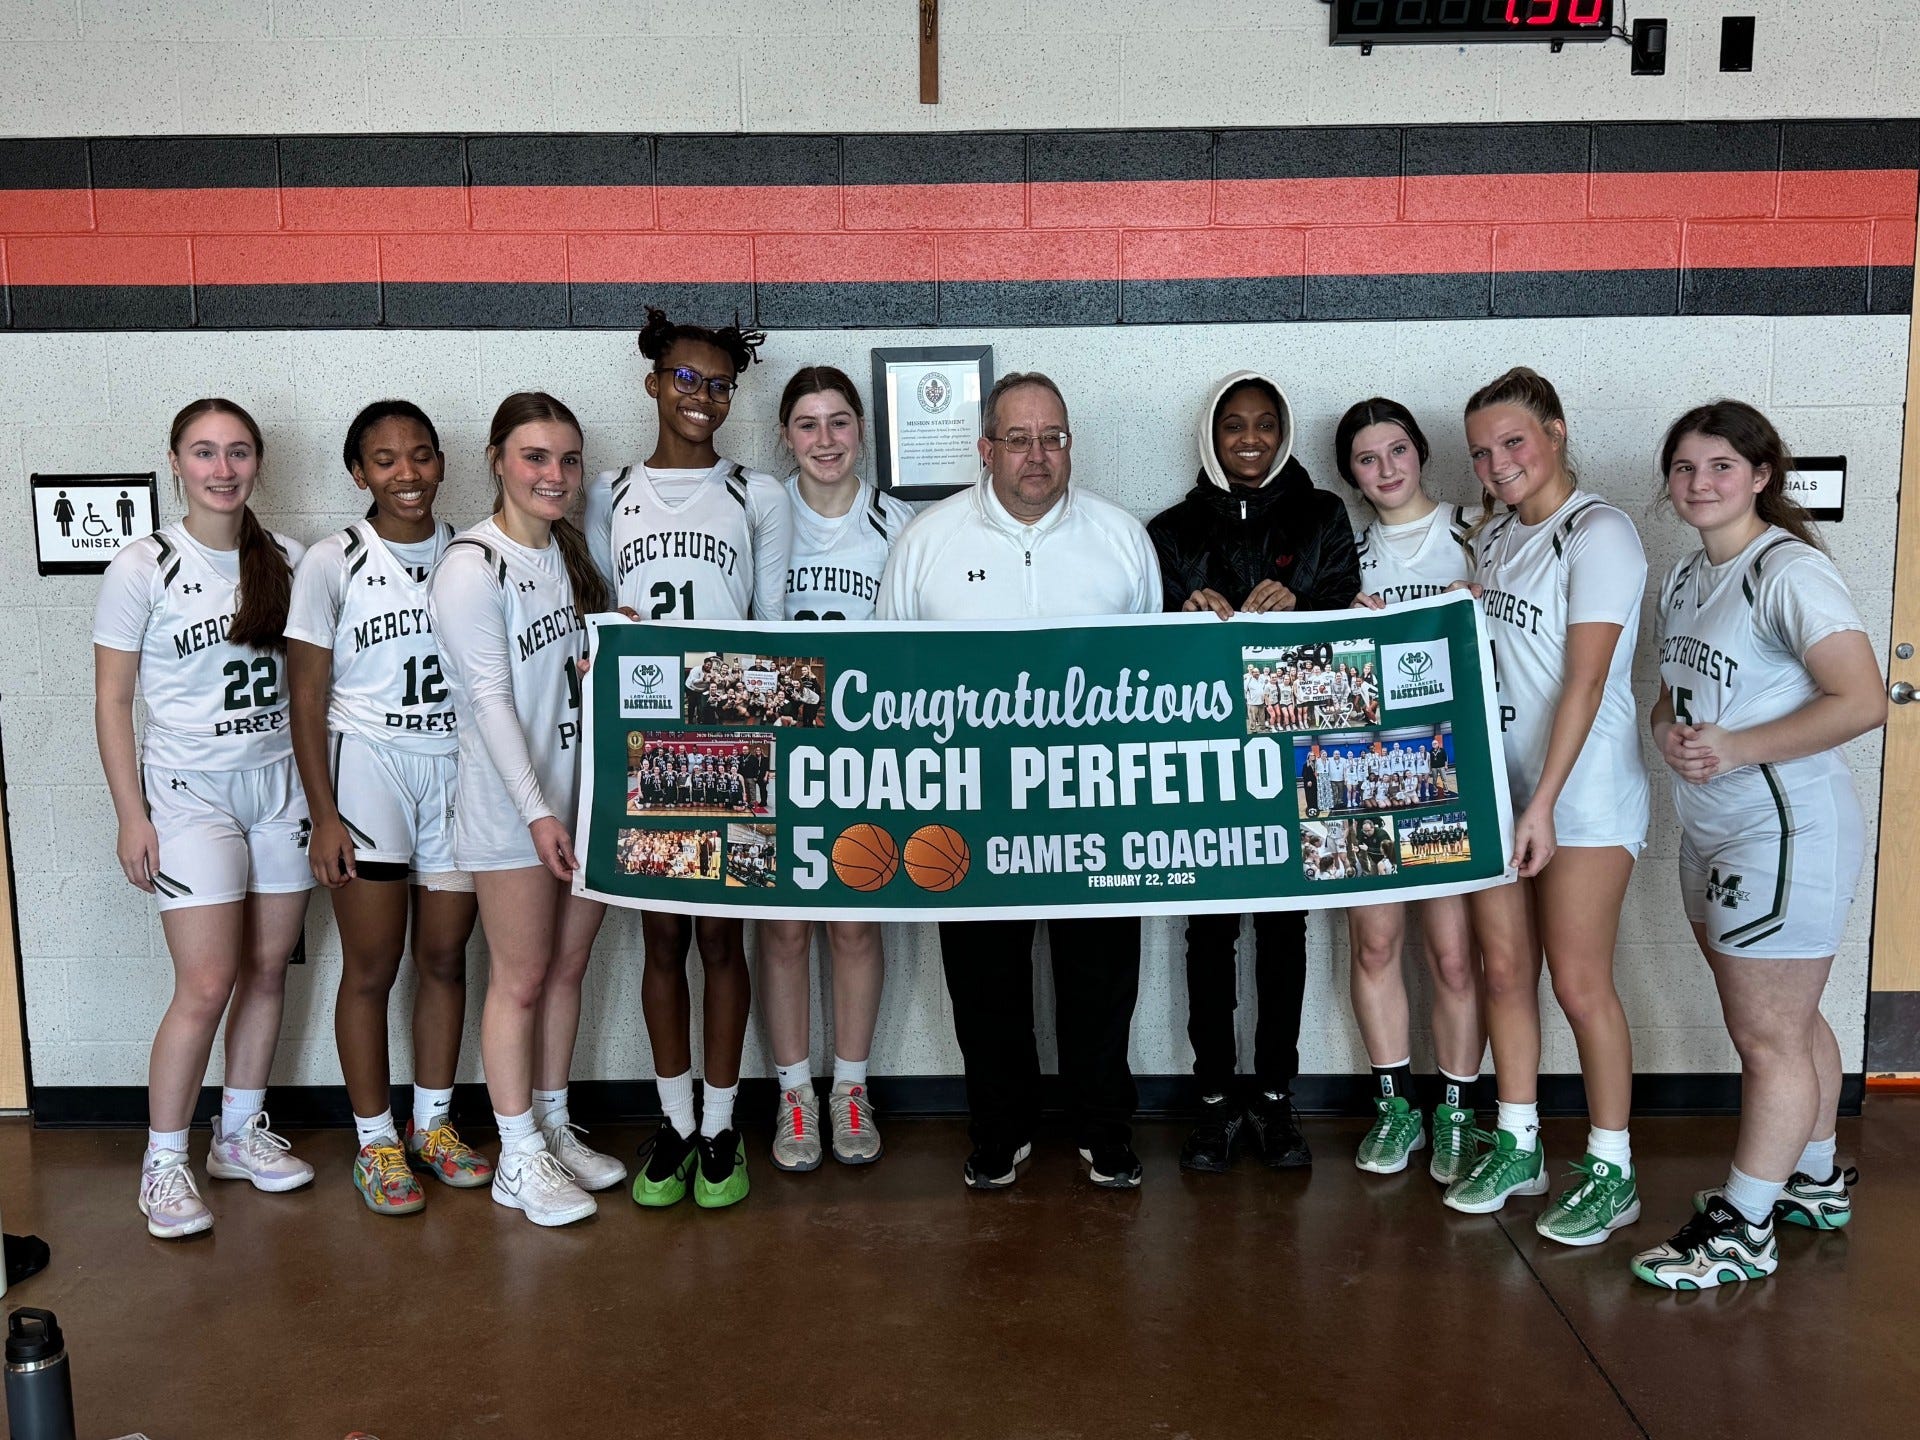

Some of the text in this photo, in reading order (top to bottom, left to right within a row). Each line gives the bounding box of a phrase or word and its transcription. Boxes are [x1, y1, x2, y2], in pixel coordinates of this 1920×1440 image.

[72, 538, 120, 548] UNISEX
[618, 531, 737, 586] MERCYHURST
[650, 580, 694, 620] 21
[785, 566, 881, 606] RCYHURST
[354, 608, 433, 653] MERCY
[517, 604, 585, 662] MERCYH
[223, 656, 278, 711] 22
[402, 654, 448, 706] 12
[1390, 683, 1445, 700] BASKETBALL
[215, 711, 284, 737] PREP
[624, 699, 673, 709] BASKETBALL
[831, 666, 1233, 745] Congratulations
[789, 736, 1284, 811] COACH PERFETTO
[986, 824, 1290, 875] GAMES COACHED
[1088, 872, 1196, 888] FEBRUARY 22, 2025
